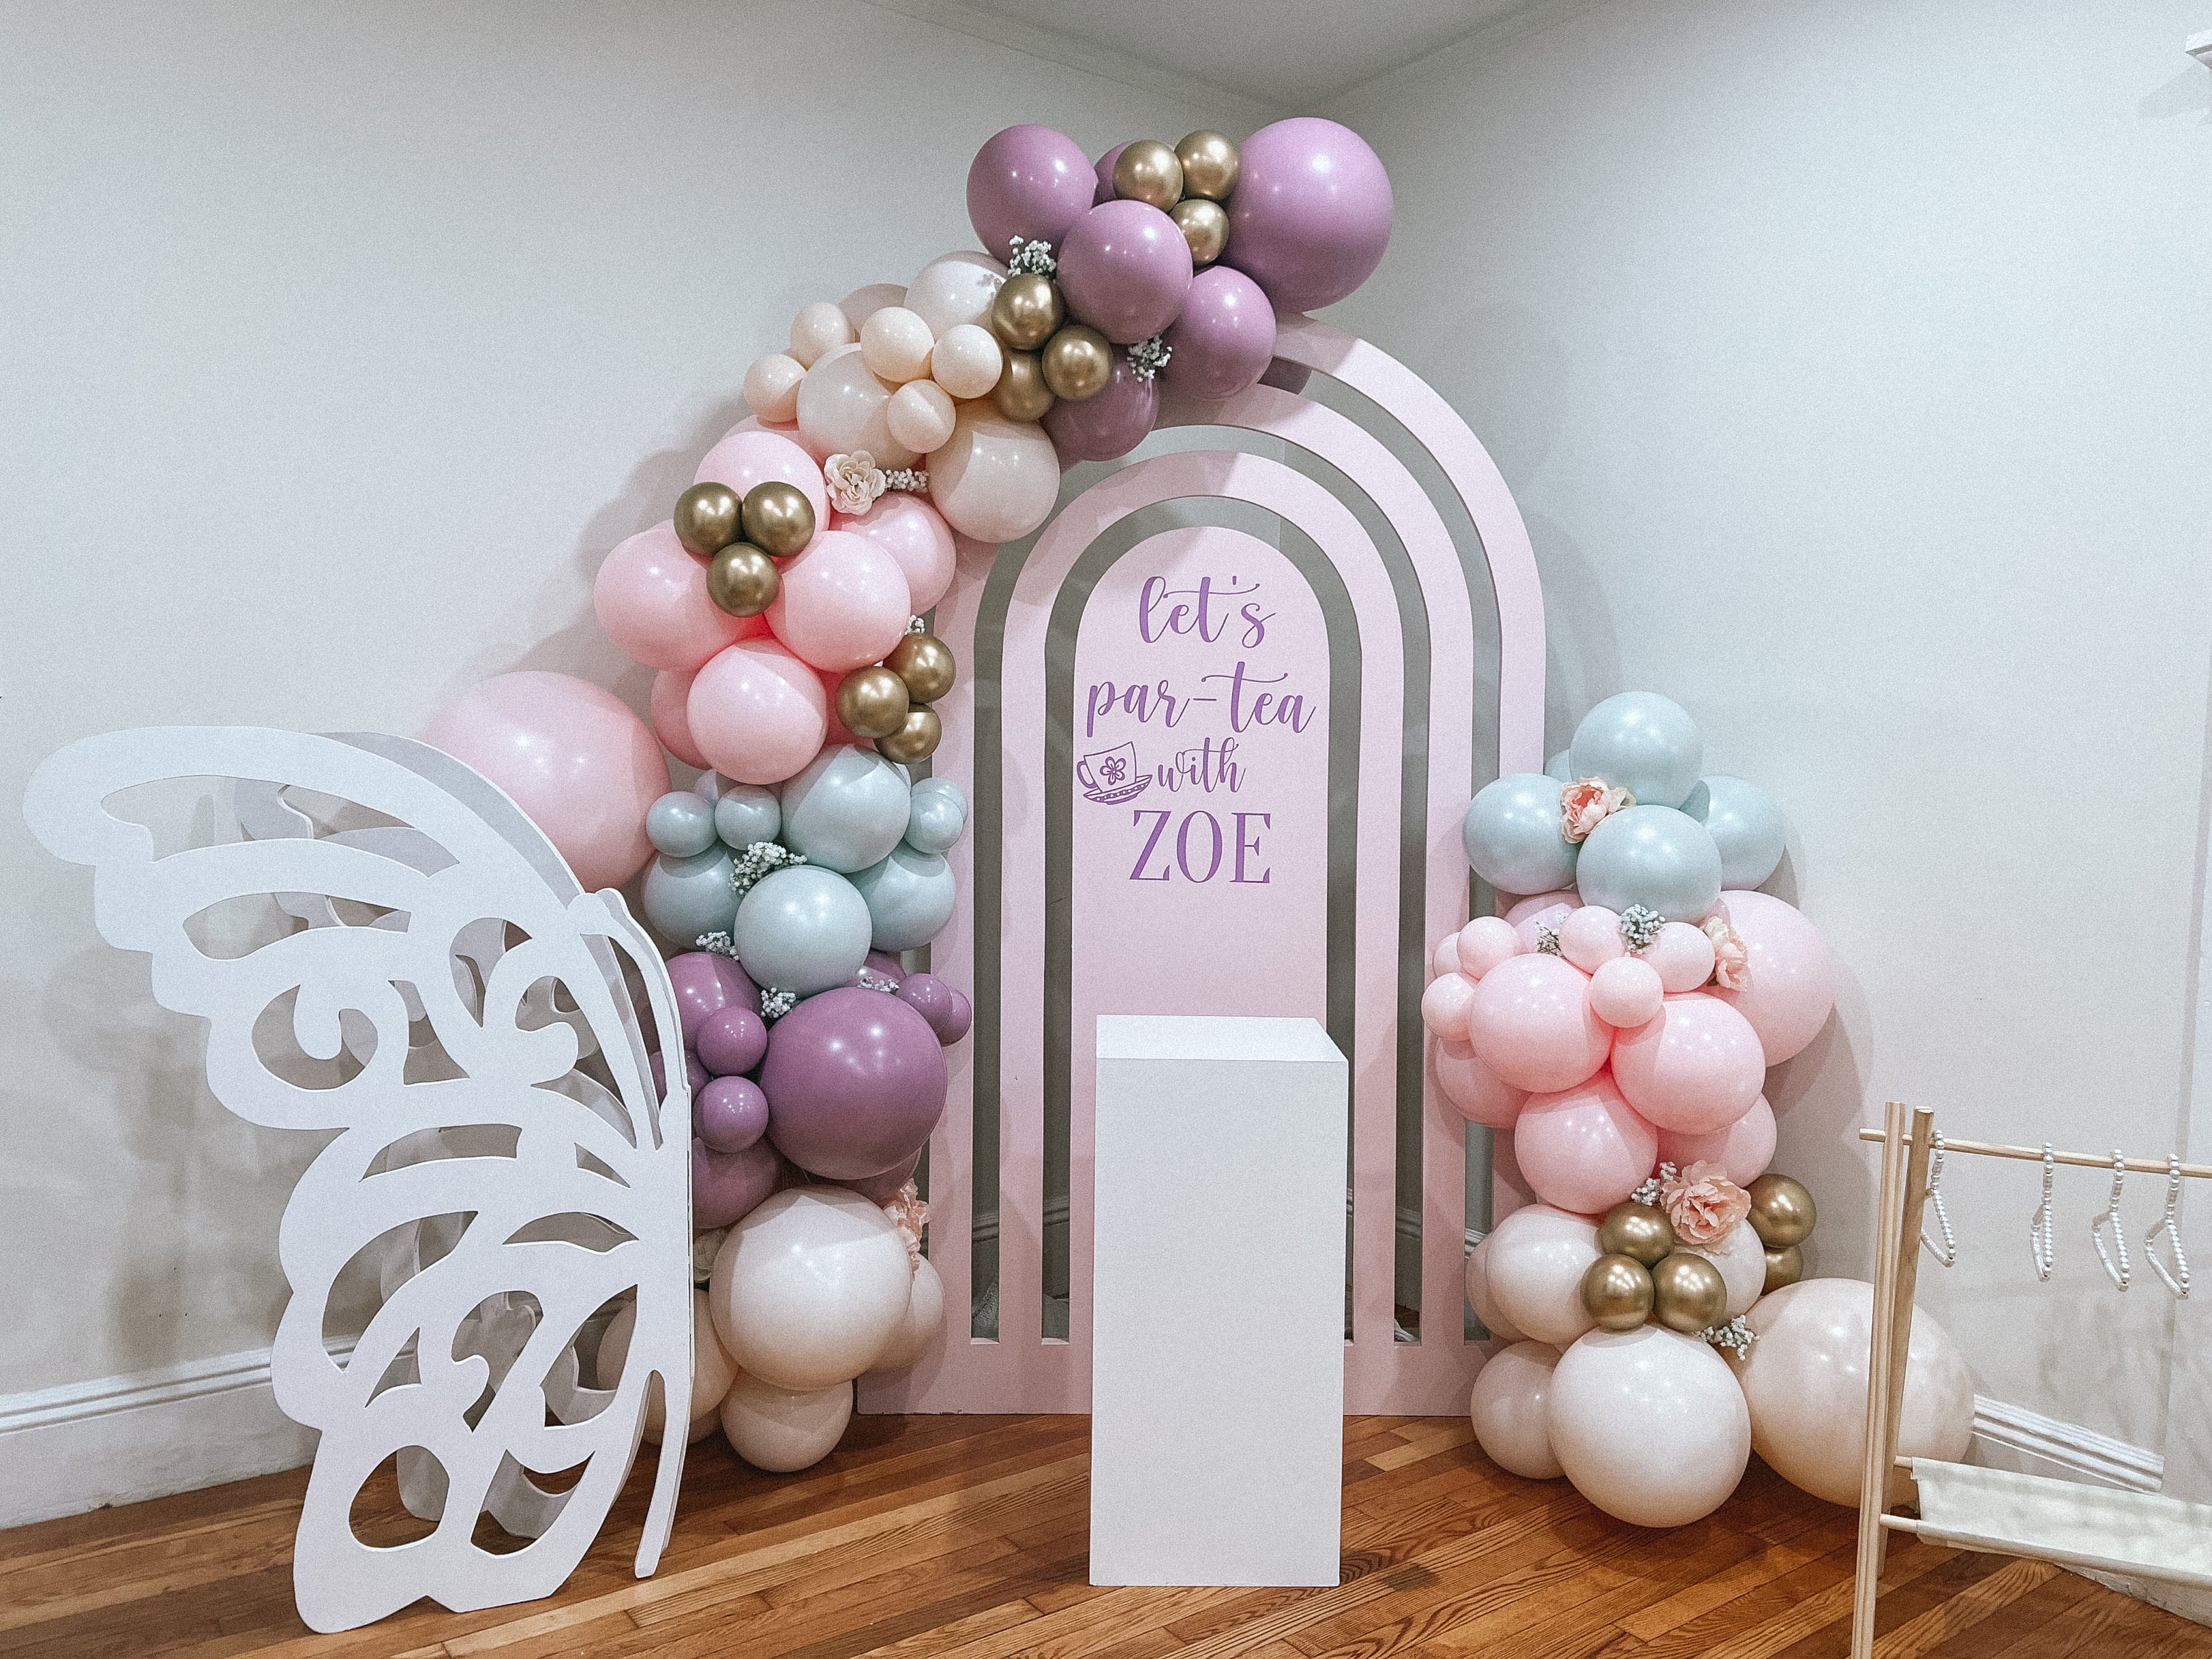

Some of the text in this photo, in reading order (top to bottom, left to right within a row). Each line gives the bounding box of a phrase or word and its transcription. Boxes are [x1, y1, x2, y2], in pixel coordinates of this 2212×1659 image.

[1139, 575, 1276, 648] let's
[1086, 661, 1316, 737] par-tea
[1157, 737, 1246, 793] with
[1129, 810, 1271, 884] ZOE
